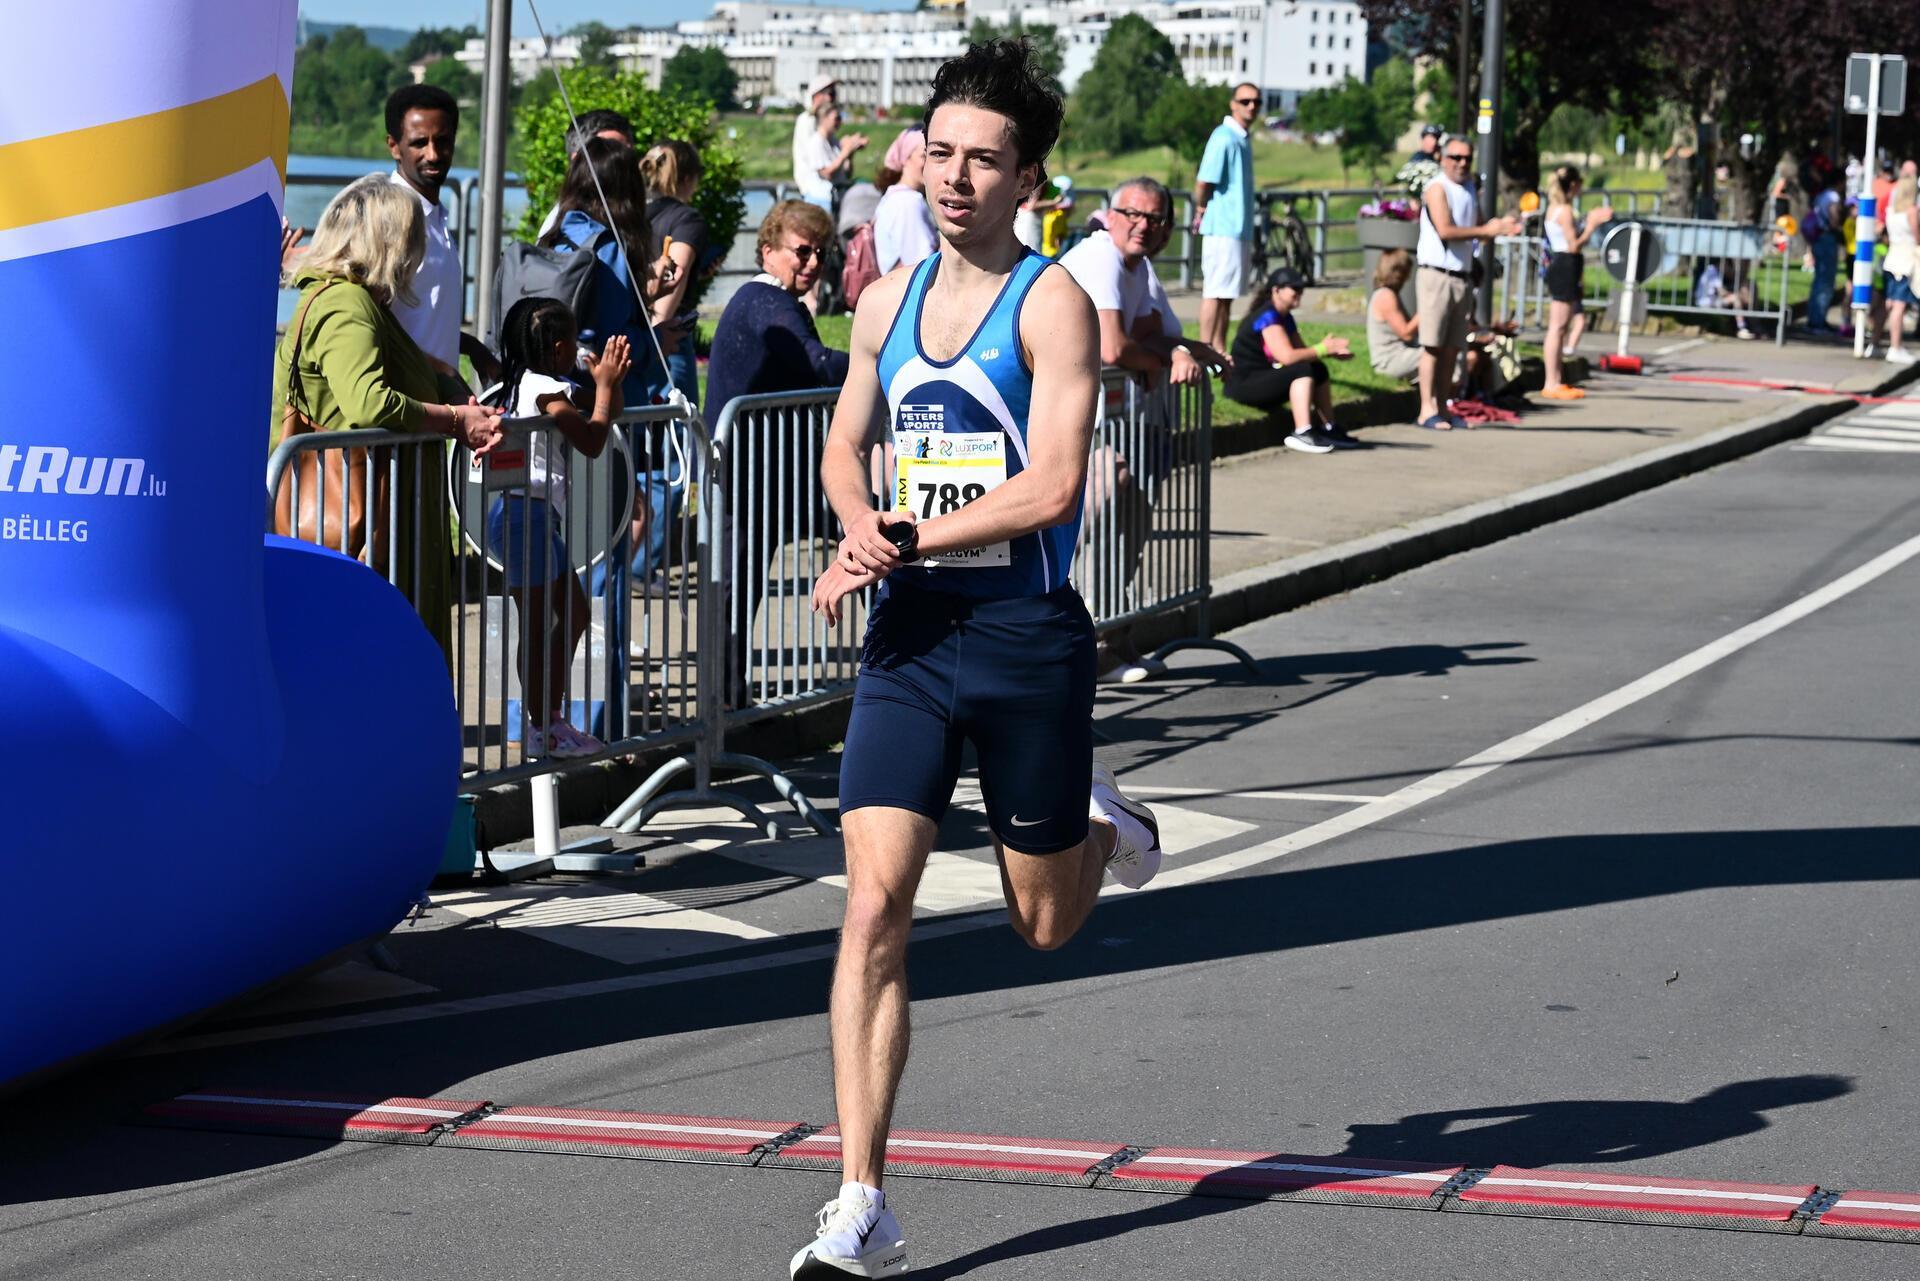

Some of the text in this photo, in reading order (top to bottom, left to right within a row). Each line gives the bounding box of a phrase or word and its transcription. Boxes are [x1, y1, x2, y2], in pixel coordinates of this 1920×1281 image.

[901, 412, 944, 421] PETERS
[903, 421, 944, 430] SPORTS
[955, 442, 998, 453] LUXPORT
[899, 478, 907, 506] KM
[2, 514, 88, 542] BËLLEG
